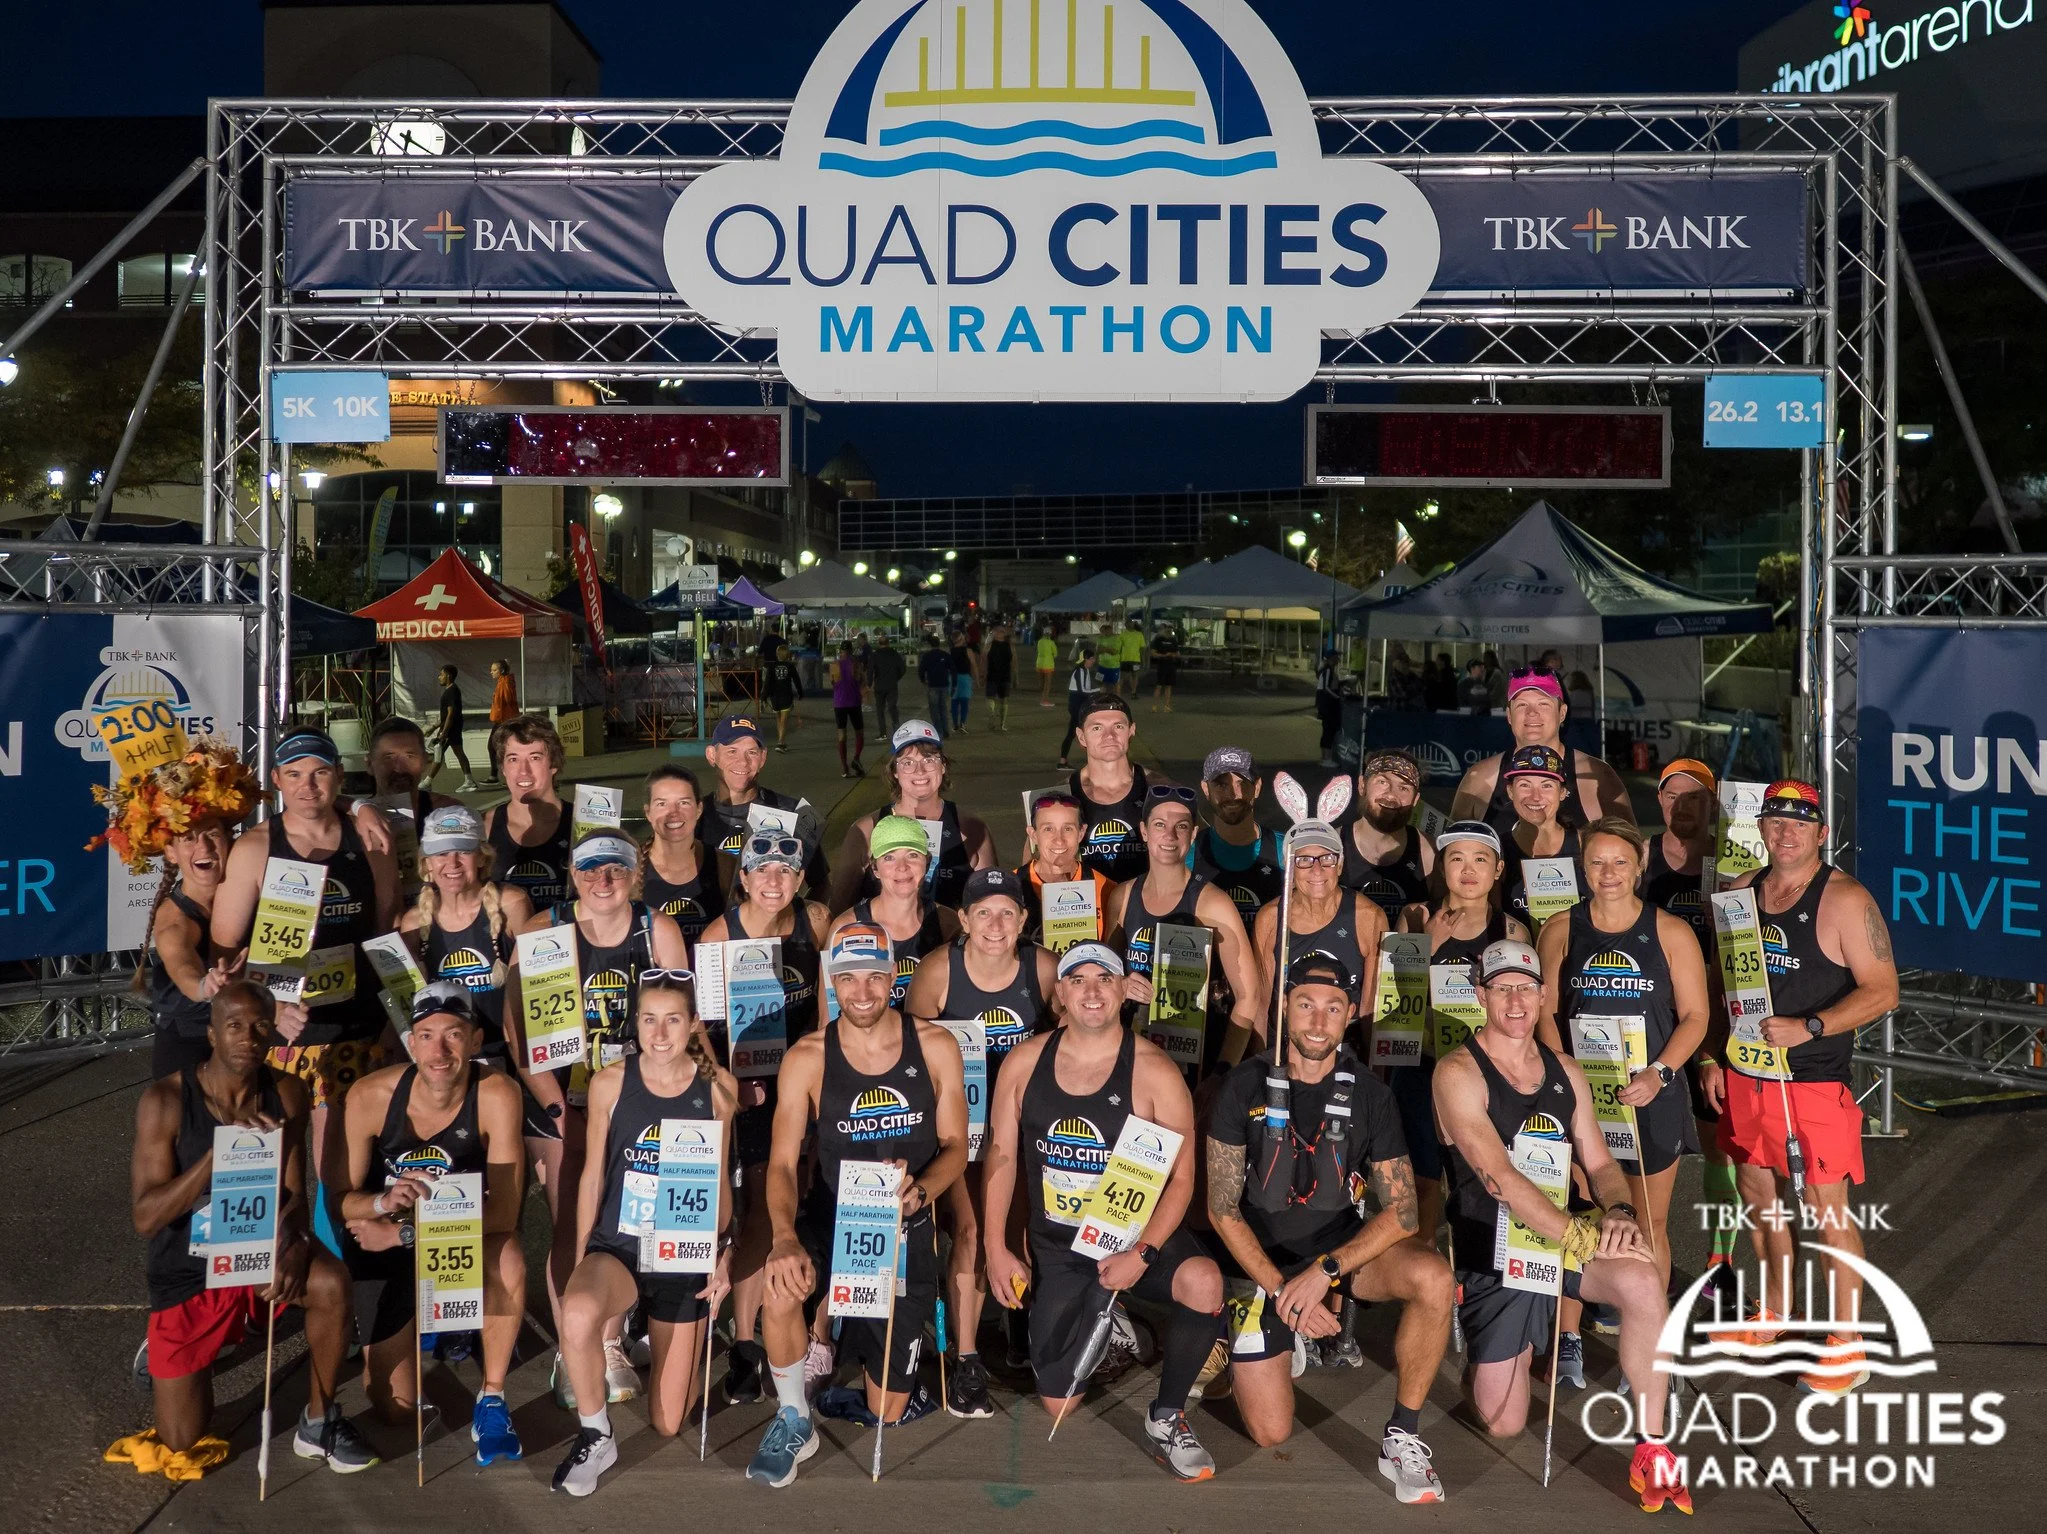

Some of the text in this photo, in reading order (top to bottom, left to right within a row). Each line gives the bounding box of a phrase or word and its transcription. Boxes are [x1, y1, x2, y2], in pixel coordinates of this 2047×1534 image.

[339, 218, 592, 252] TBK BANK
[1484, 215, 1750, 251] TBK BANK
[706, 202, 1388, 287] QUAD CITIES
[820, 305, 1272, 354] MARATHON
[282, 396, 379, 418] 5K 10K
[1708, 401, 1823, 422] 26.2 13.1
[682, 593, 716, 603] PR BELL
[376, 620, 471, 639] MEDICAL
[1501, 625, 1530, 633] CITIES
[108, 652, 177, 661] TBK BANK
[101, 700, 175, 745] 2:00
[127, 734, 176, 765] HALF
[1892, 733, 2047, 796] RUN
[1888, 800, 2029, 865] THE
[1723, 839, 1764, 859] 3:50
[128, 883, 156, 892] ROCK
[270, 884, 315, 897] QUAD CITIES
[128, 898, 154, 908] ARSE
[268, 904, 306, 915] MARATHON
[323, 902, 362, 916] CITIES
[1893, 868, 2041, 937] RIVE
[1718, 914, 1734, 922] QUAD
[260, 923, 305, 949] 3:45
[1723, 933, 1753, 942] MARATHON
[267, 948, 290, 958] PACE
[525, 951, 569, 967] QUAD CITIES
[1182, 950, 1203, 958] CITIES
[732, 962, 777, 972] QUAD CITIES
[1725, 951, 1759, 974] 4:35
[530, 972, 570, 986] MARATHON
[1161, 968, 1200, 979] MARATHON
[306, 971, 344, 992] 609
[1571, 977, 1654, 991] QUAD CITIES
[784, 987, 812, 1004] CITIES
[1584, 990, 1641, 998] MARATHON
[530, 990, 575, 1020] 5:25
[1381, 994, 1423, 1016] 5:00
[734, 1001, 781, 1025] 2:40
[544, 1017, 564, 1027] PACE
[550, 1037, 579, 1049] RILCO
[1738, 1046, 1774, 1066] 373
[1599, 1107, 1617, 1115] PACE
[837, 1112, 923, 1134] QUAD CITIES
[852, 1126, 911, 1141] MARATHON
[1606, 1132, 1633, 1140] RILCO
[248, 1151, 274, 1159] CITIES
[625, 1148, 659, 1162] QUAD
[666, 1145, 689, 1153] QUAD
[1037, 1140, 1112, 1162] QUAD CITIE
[1123, 1142, 1167, 1164] QUAD CITIES
[1048, 1157, 1106, 1171] MARATHON
[1117, 1162, 1153, 1180] MARATHON
[1518, 1162, 1562, 1176] QUAD CITIES
[844, 1188, 867, 1196] QUAD
[1104, 1182, 1145, 1213] 4:10
[424, 1203, 448, 1211] QUAD
[667, 1188, 708, 1212] 1:45
[1056, 1194, 1092, 1214] 59
[221, 1195, 265, 1222] 1:40
[859, 1211, 894, 1219] MARATHON
[1106, 1207, 1130, 1222] PACE
[675, 1215, 699, 1223] PACE
[230, 1224, 256, 1234] PACE
[429, 1225, 470, 1233] MARATHON
[844, 1231, 885, 1256] 1:50
[1525, 1235, 1545, 1245] PACE
[235, 1252, 270, 1261] RILCO
[427, 1246, 473, 1272] 3:55
[852, 1259, 876, 1268] PACE
[1527, 1262, 1557, 1272] RILCO
[439, 1273, 464, 1283] PACE
